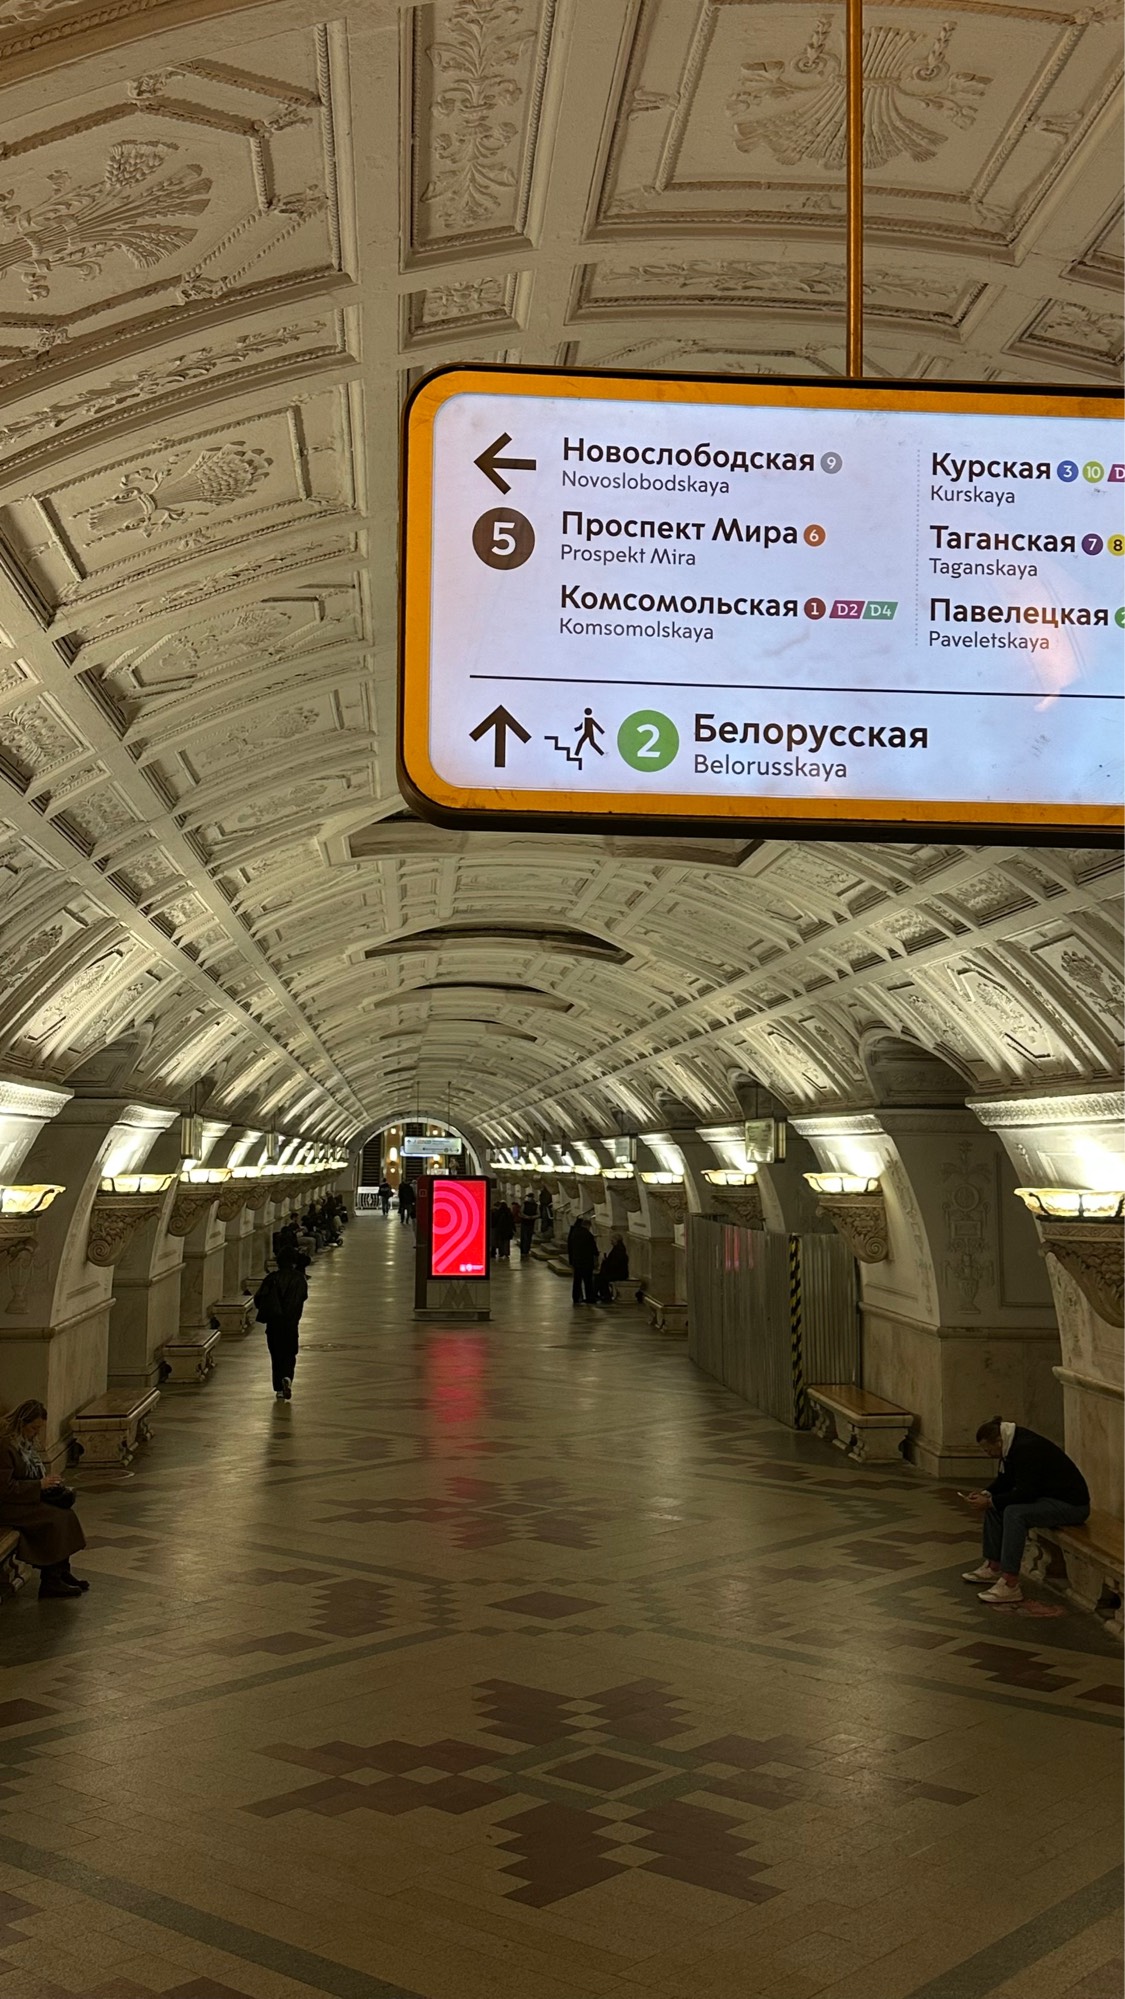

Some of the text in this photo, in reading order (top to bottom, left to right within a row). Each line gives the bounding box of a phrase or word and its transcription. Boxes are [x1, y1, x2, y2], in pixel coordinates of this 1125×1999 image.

[562, 437, 815, 472] Новослободская
[932, 453, 1051, 482] Курская
[562, 471, 730, 496] Novoslobodskaya
[931, 485, 1015, 506] Kurskaya
[491, 521, 516, 556] 5
[561, 511, 706, 541] Проспект
[711, 518, 798, 548] Мира
[929, 525, 1076, 552] Таганская
[561, 544, 696, 565] Prospekt Mira
[928, 558, 1038, 580] Taganskaya
[560, 585, 798, 616] Комсомольская
[930, 598, 1109, 628] Павелецкая
[559, 618, 714, 642] Komsomolskaya
[929, 631, 1049, 652] Paveletskaya
[636, 714, 928, 758] 2 Белорусская
[694, 754, 847, 781] Belorusskaya
